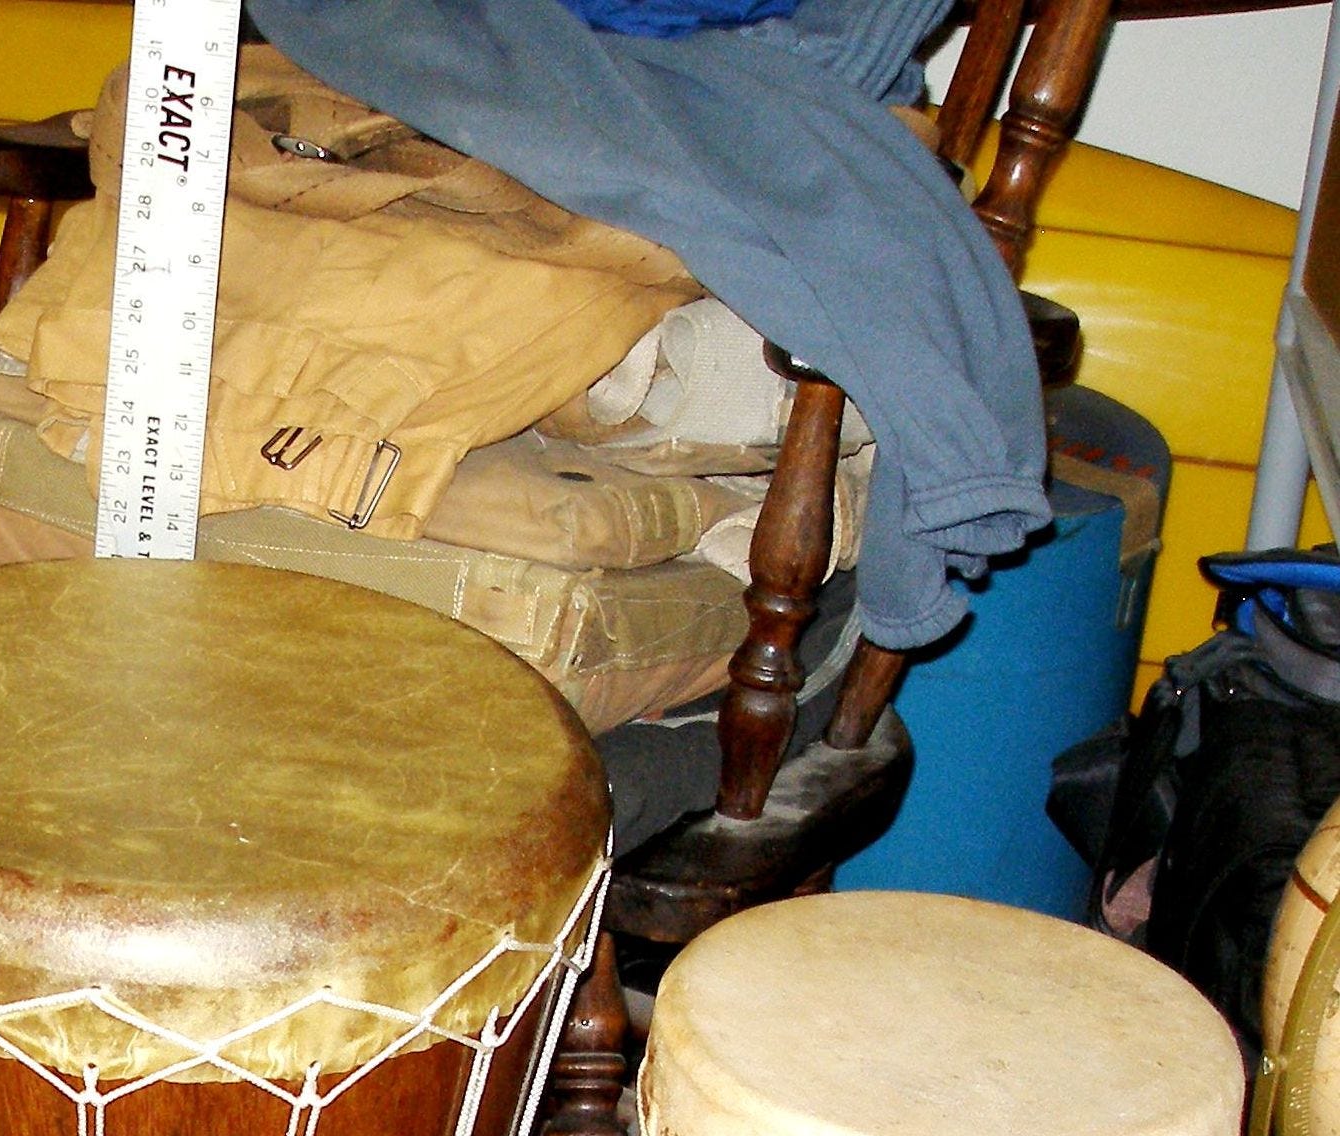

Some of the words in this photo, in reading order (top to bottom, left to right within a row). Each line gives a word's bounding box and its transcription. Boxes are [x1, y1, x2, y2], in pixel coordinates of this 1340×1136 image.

[148, 39, 163, 60] 31
[205, 41, 219, 52] 5
[145, 87, 159, 114] 30
[200, 96, 214, 107] 6
[157, 64, 196, 173] EXACT
[140, 141, 155, 168] 29
[196, 150, 210, 160] 7
[137, 194, 152, 220] 28
[191, 202, 206, 213] 8
[132, 245, 147, 273] 27
[188, 254, 202, 265] 9
[129, 298, 143, 323] 26
[182, 311, 196, 330] 10
[125, 349, 140, 374] 25
[179, 361, 192, 376] 11
[121, 400, 135, 425] 24
[174, 413, 188, 431] 12
[144, 416, 160, 467] EXACT
[117, 450, 131, 475] 23
[169, 464, 183, 482] 13
[140, 475, 155, 523] LEVEL
[113, 499, 128, 524] 22
[166, 512, 180, 531] 14
[137, 531, 152, 542] &
